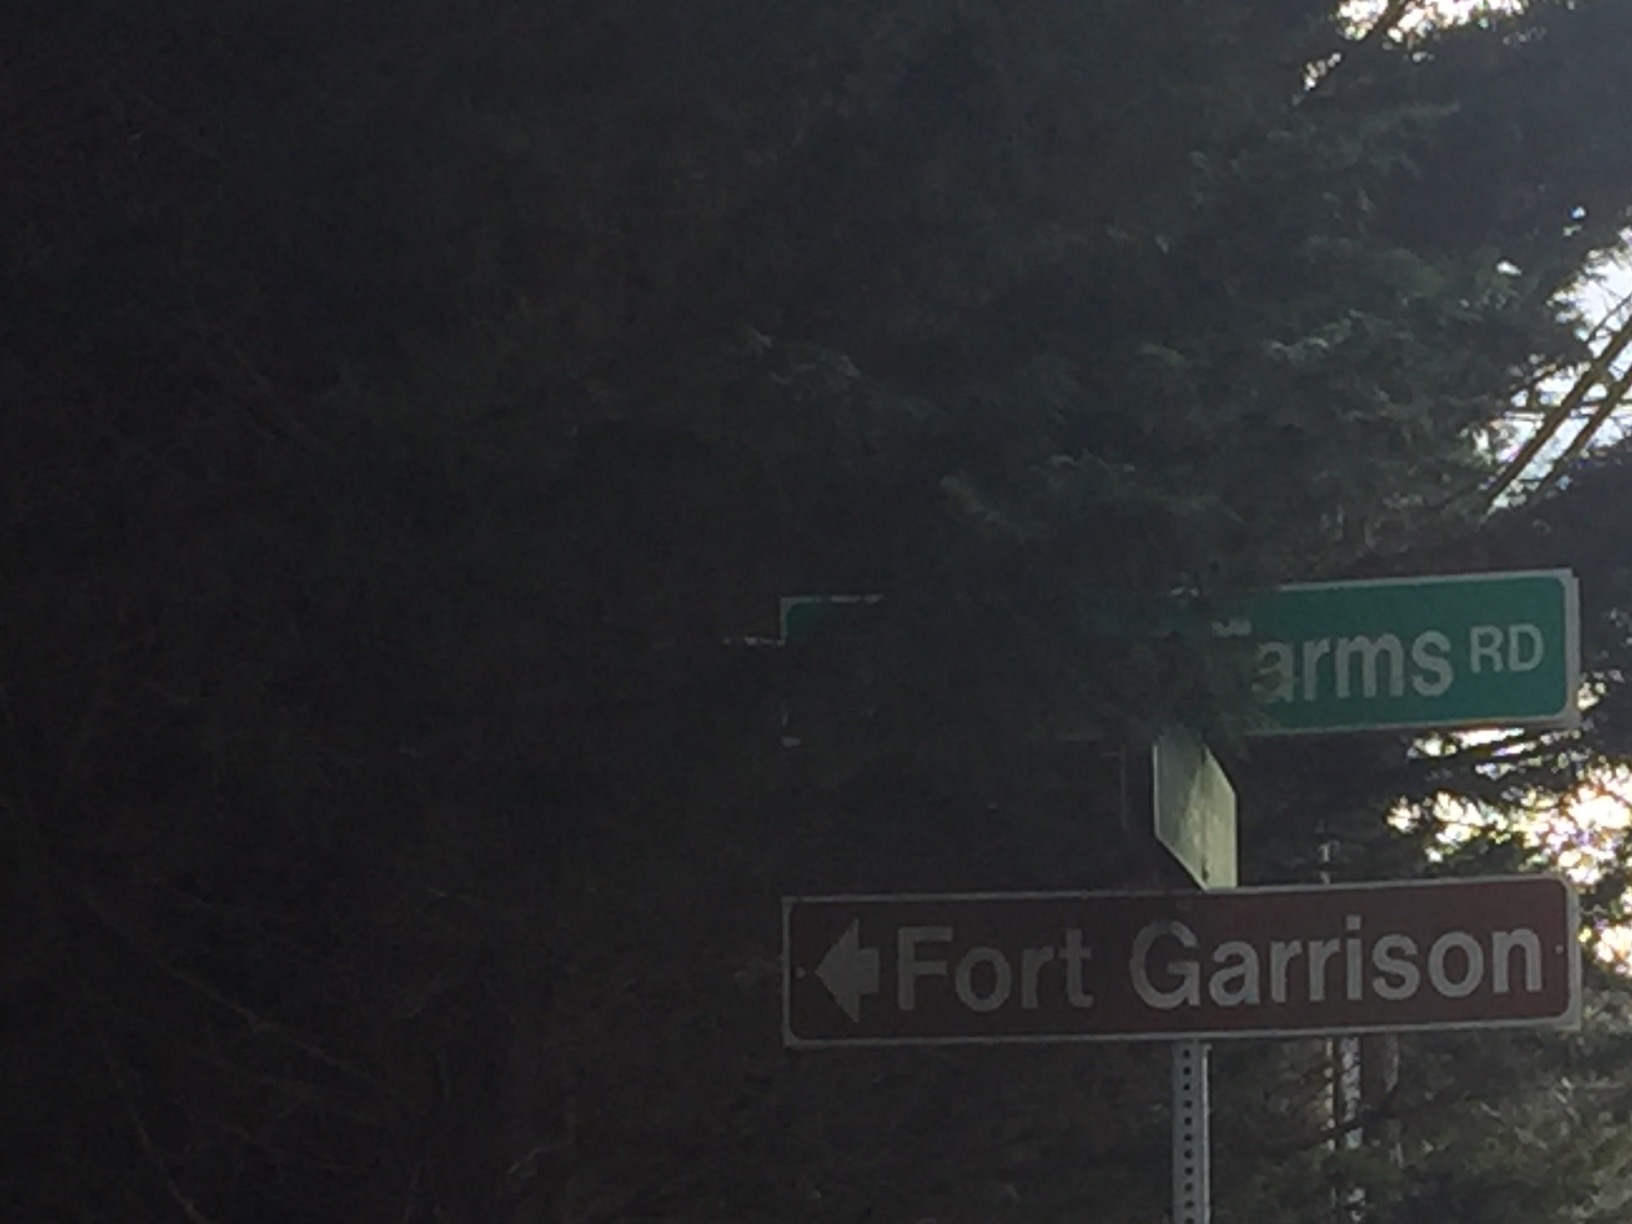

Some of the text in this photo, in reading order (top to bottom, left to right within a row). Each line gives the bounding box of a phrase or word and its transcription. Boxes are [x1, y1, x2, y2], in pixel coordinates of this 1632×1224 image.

[1469, 623, 1545, 674] RD
[897, 914, 1543, 1012] Fort Garrison
